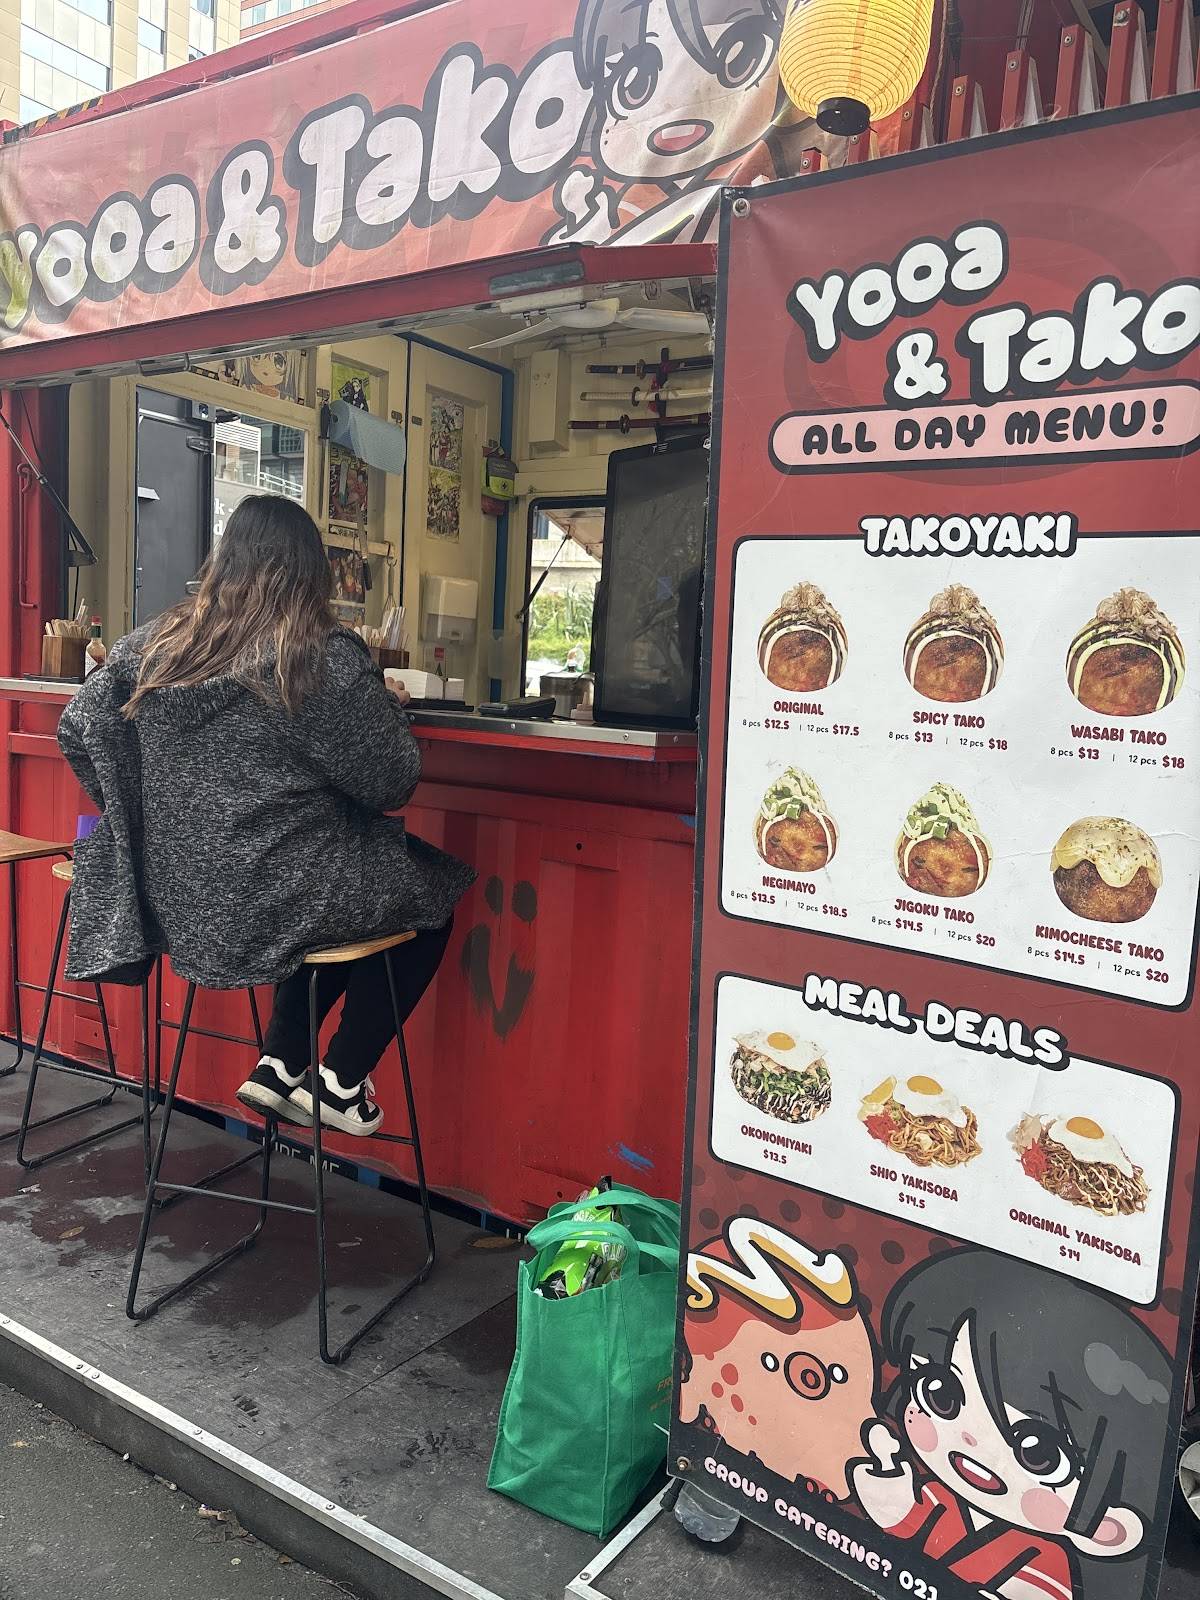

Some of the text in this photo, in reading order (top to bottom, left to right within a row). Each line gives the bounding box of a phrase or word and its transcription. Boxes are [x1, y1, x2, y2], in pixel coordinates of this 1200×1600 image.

[212, 150, 282, 274] &
[298, 50, 594, 245] Tako
[893, 282, 1200, 400] & Tako
[802, 398, 1168, 456] ALL DAY MENU!
[861, 514, 1072, 553] TAKOYAKI
[774, 701, 824, 715] ORIGINAL
[913, 711, 985, 728] SPICY TAKO
[765, 719, 789, 730] $12.5
[833, 724, 859, 736] $17.5
[915, 731, 933, 743] $13
[989, 738, 1008, 750] $18
[1071, 725, 1167, 745] WASABI TAKO
[1050, 746, 1185, 769] 8 pcs $13 12 pcs $18
[762, 876, 816, 894] NEGIMAYO
[752, 892, 776, 904] $13.5
[823, 904, 848, 918] $18.5
[895, 899, 975, 924] JIGOKU TAKO
[896, 918, 923, 932] $14.5
[958, 933, 972, 941] pcs
[976, 934, 996, 947] $20
[1036, 925, 1164, 961] KIMOCHEESE TAKO
[1035, 949, 1050, 958] pcs
[1055, 949, 1085, 965] $14.5
[1114, 965, 1123, 973] 12
[1125, 967, 1141, 977] pcs
[1146, 969, 1169, 984] $20
[804, 974, 1063, 1064] MEAL DEALS
[741, 1125, 812, 1155] OKONOMIYAKI
[763, 1149, 787, 1164] $13.5
[870, 1164, 959, 1202] SHIO YAKISOBA
[898, 1191, 926, 1209] $14.5
[1009, 1208, 1142, 1266] ORIGINAL YAKISOBA
[1059, 1245, 1081, 1262] $14
[704, 1457, 769, 1503] GROUP
[774, 1498, 893, 1577] CATERING?
